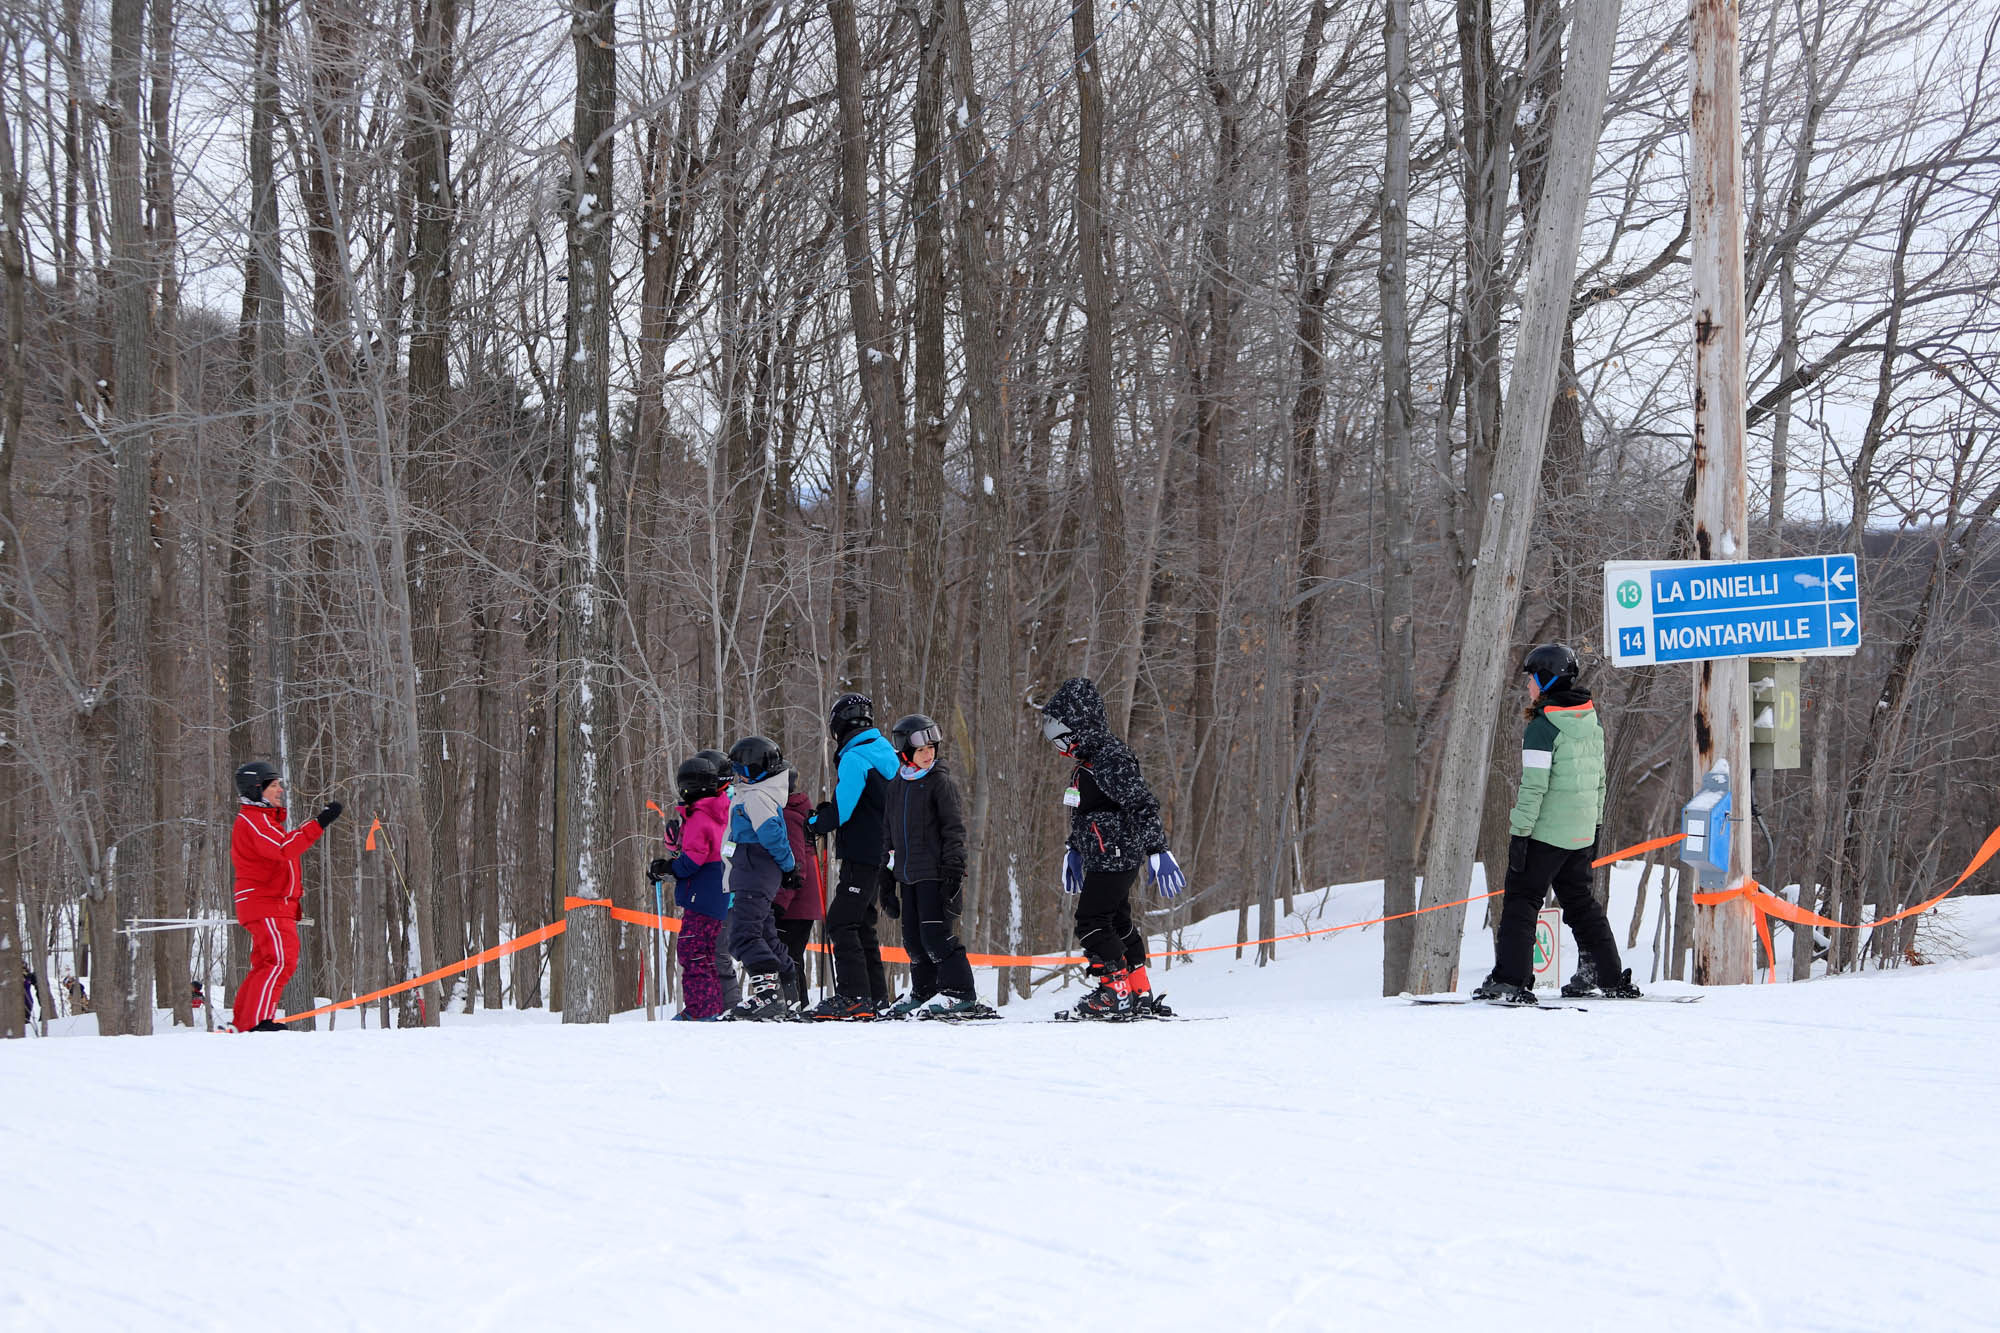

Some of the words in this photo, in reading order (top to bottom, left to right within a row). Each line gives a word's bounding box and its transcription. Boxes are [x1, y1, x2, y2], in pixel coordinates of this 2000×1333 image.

[1619, 584, 1639, 604] 13
[1656, 582, 1685, 604] LA
[1690, 573, 1780, 599] DINIELLI
[1622, 632, 1643, 651] 14
[1659, 618, 1811, 651] MONTARVILLE
